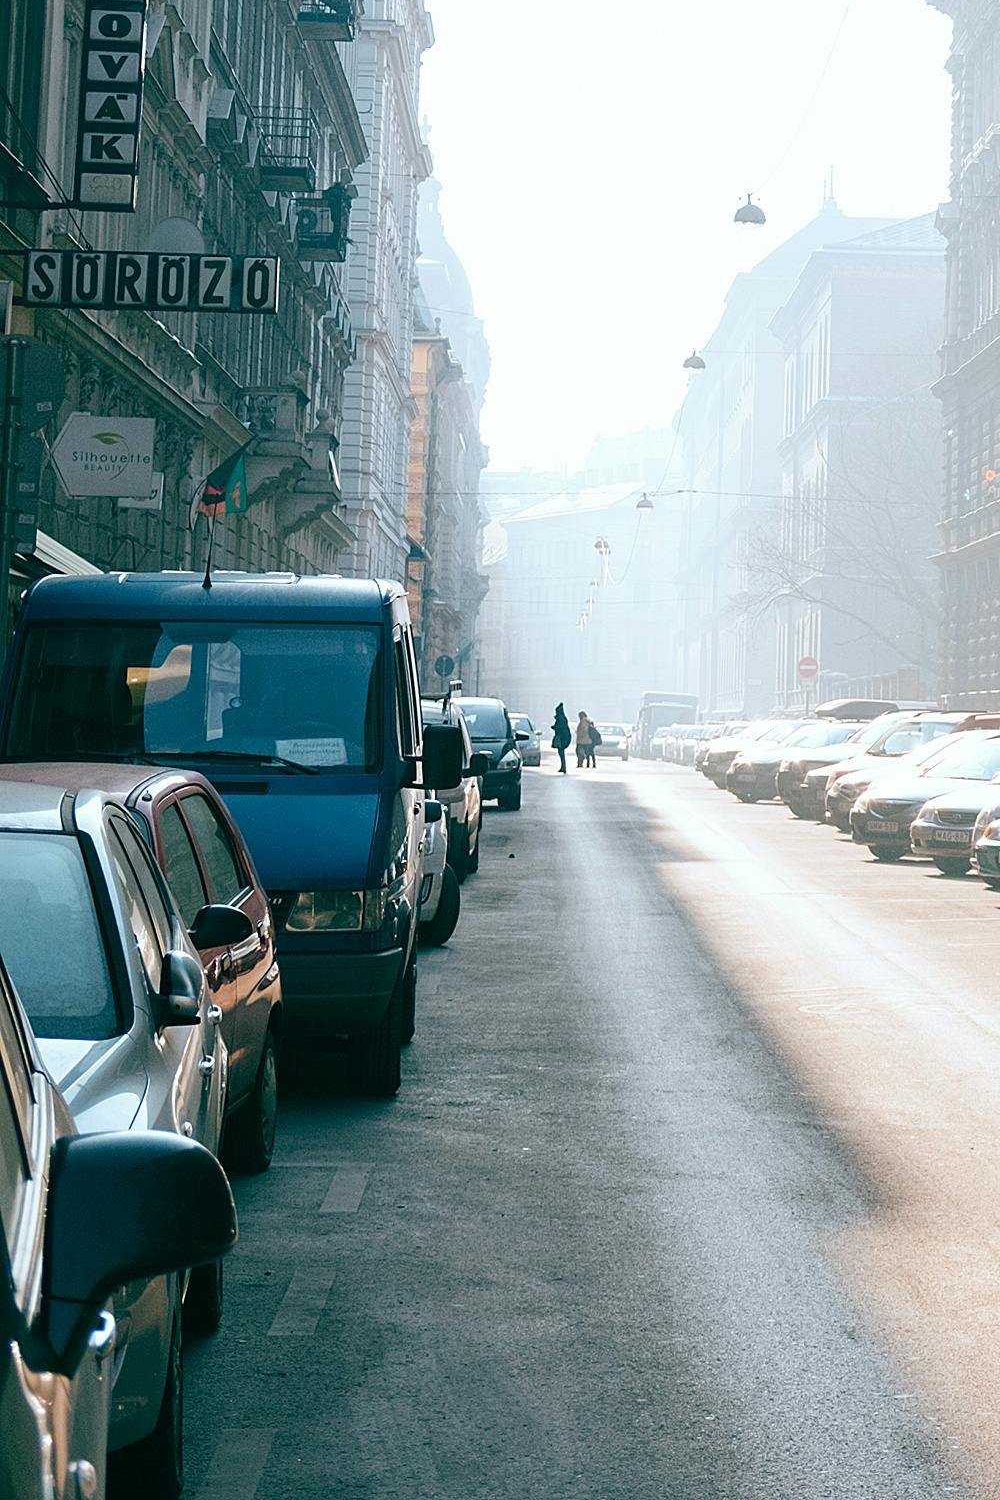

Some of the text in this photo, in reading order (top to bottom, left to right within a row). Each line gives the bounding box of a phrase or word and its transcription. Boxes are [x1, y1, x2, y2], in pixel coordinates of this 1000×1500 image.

[31, 253, 270, 308] SÖRÖZŐ
[72, 451, 151, 464] Silhouette
[84, 463, 122, 472] BEAUTY
